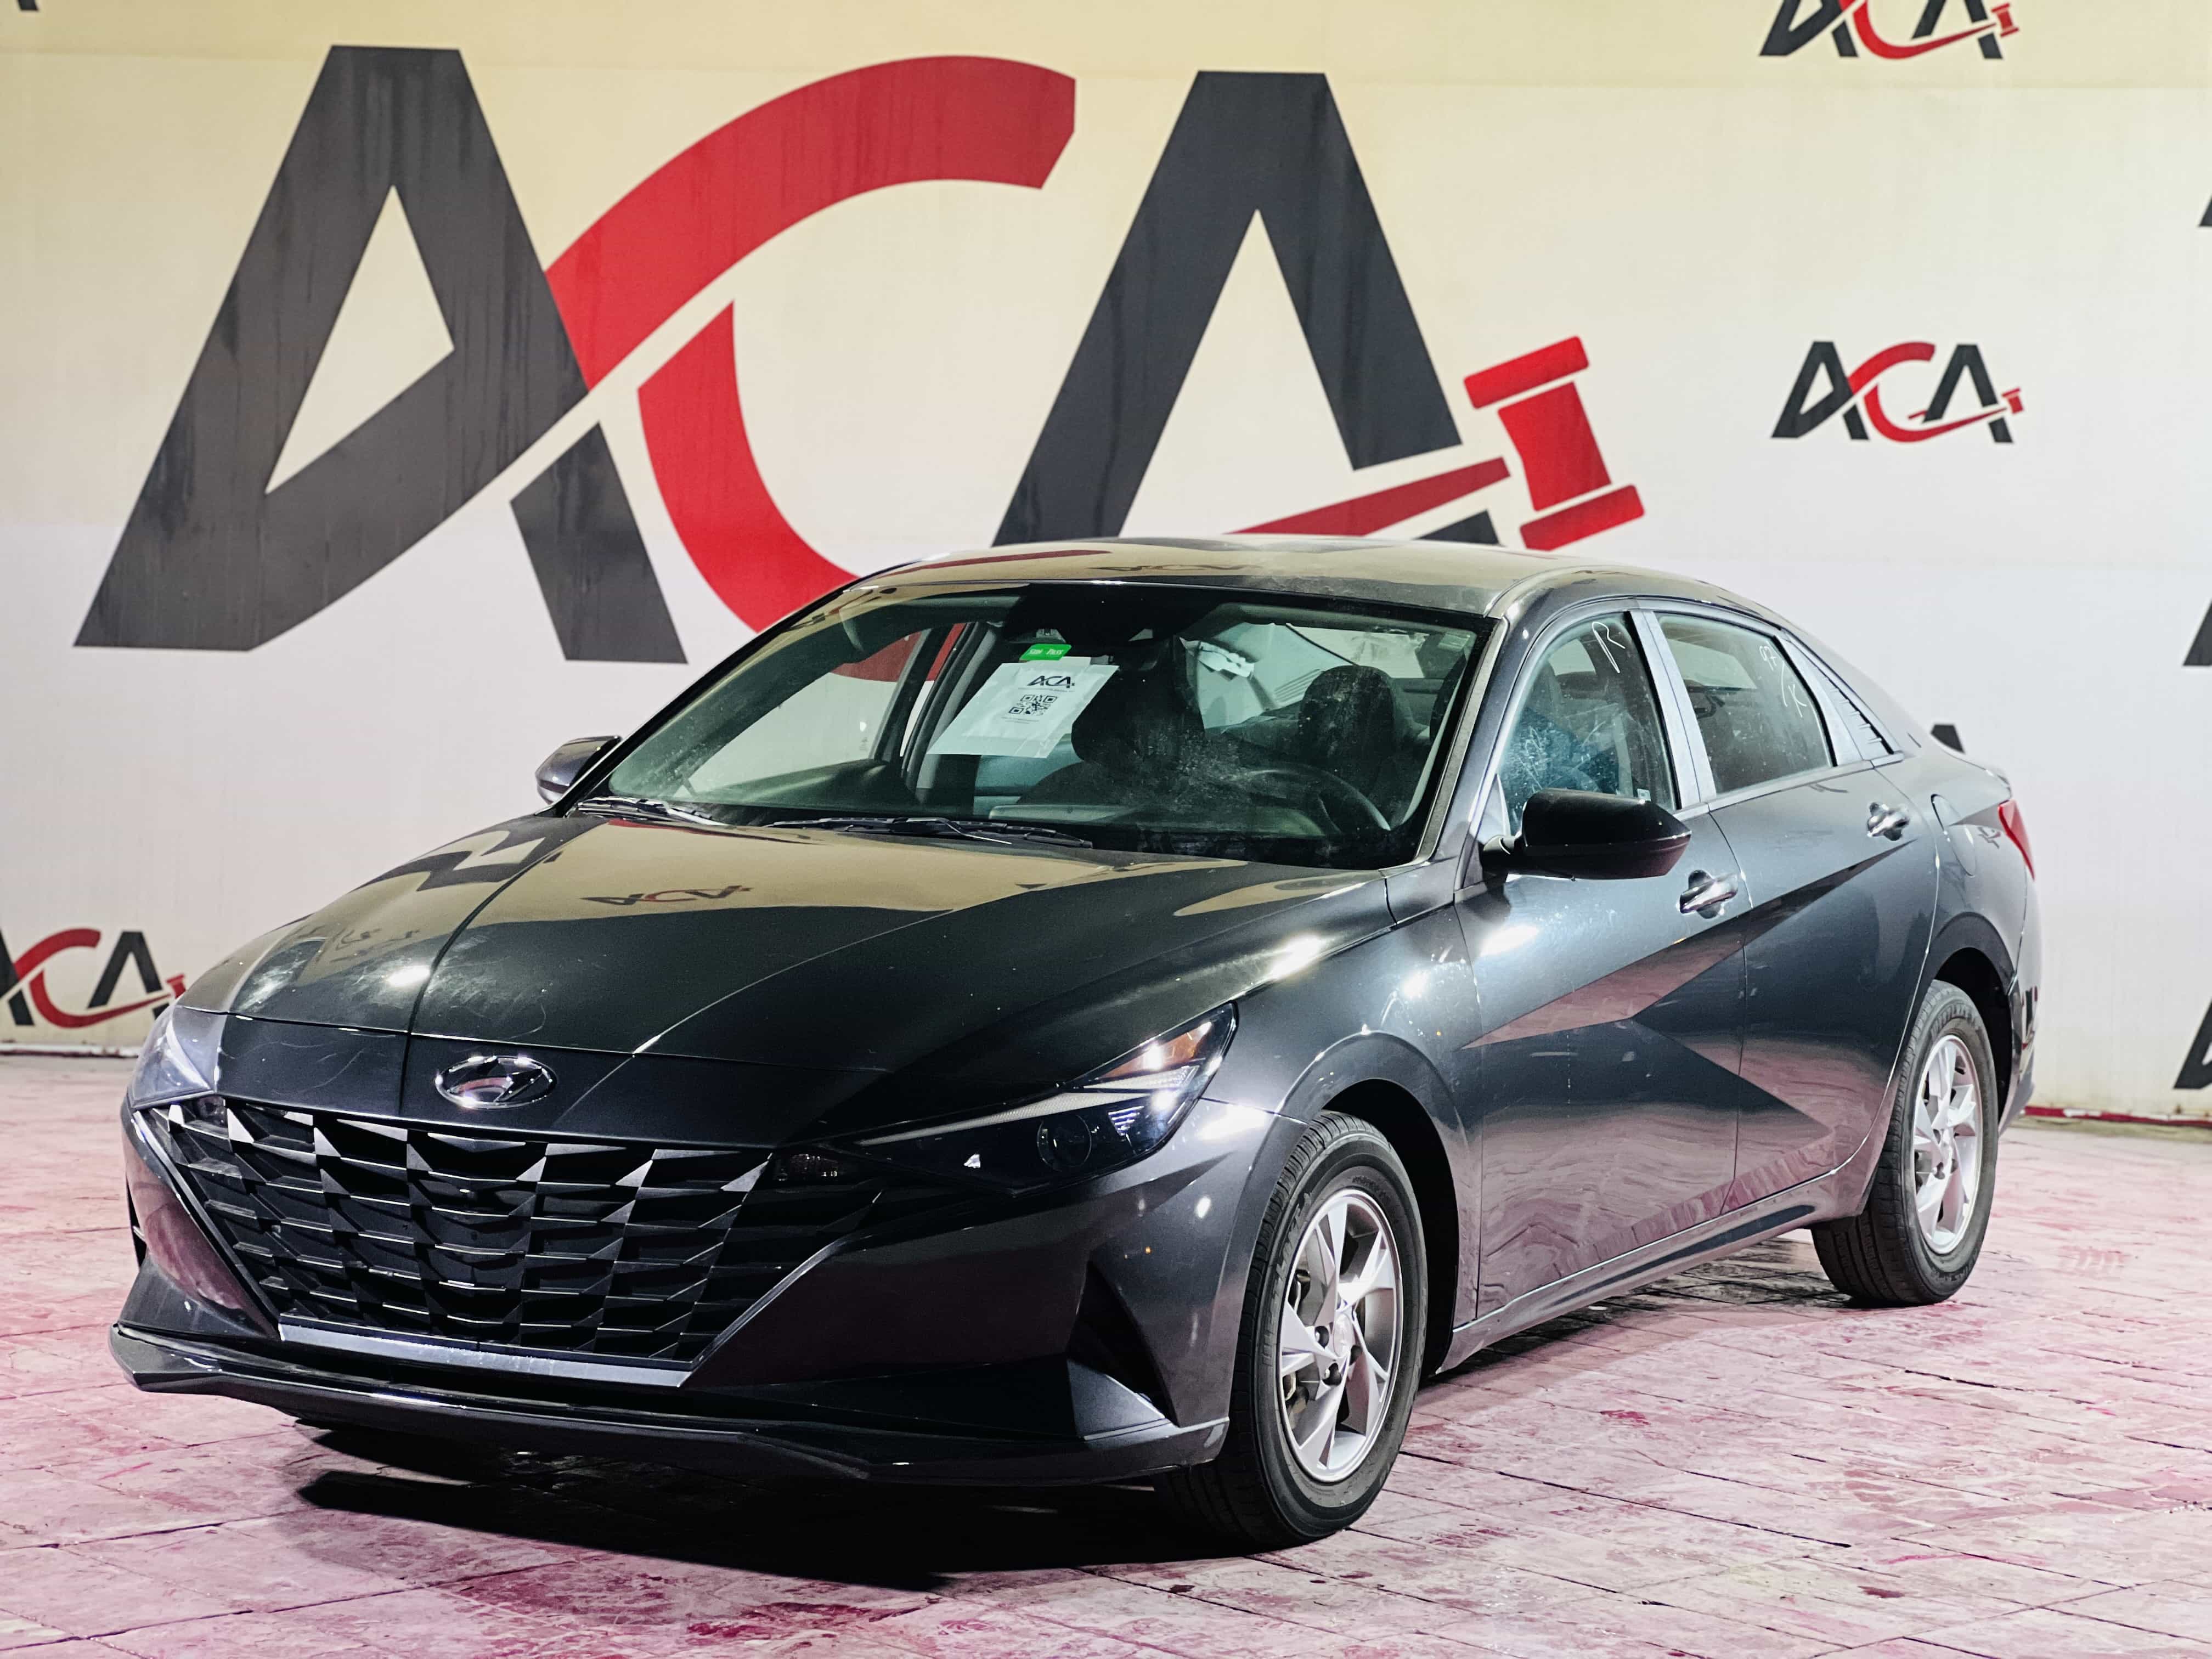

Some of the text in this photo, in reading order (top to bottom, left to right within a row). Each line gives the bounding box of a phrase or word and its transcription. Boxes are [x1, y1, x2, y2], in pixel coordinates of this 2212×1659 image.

[75, 45, 1502, 663] ACA
[1770, 341, 2014, 443] ACA
[1026, 675, 1071, 689] ACA
